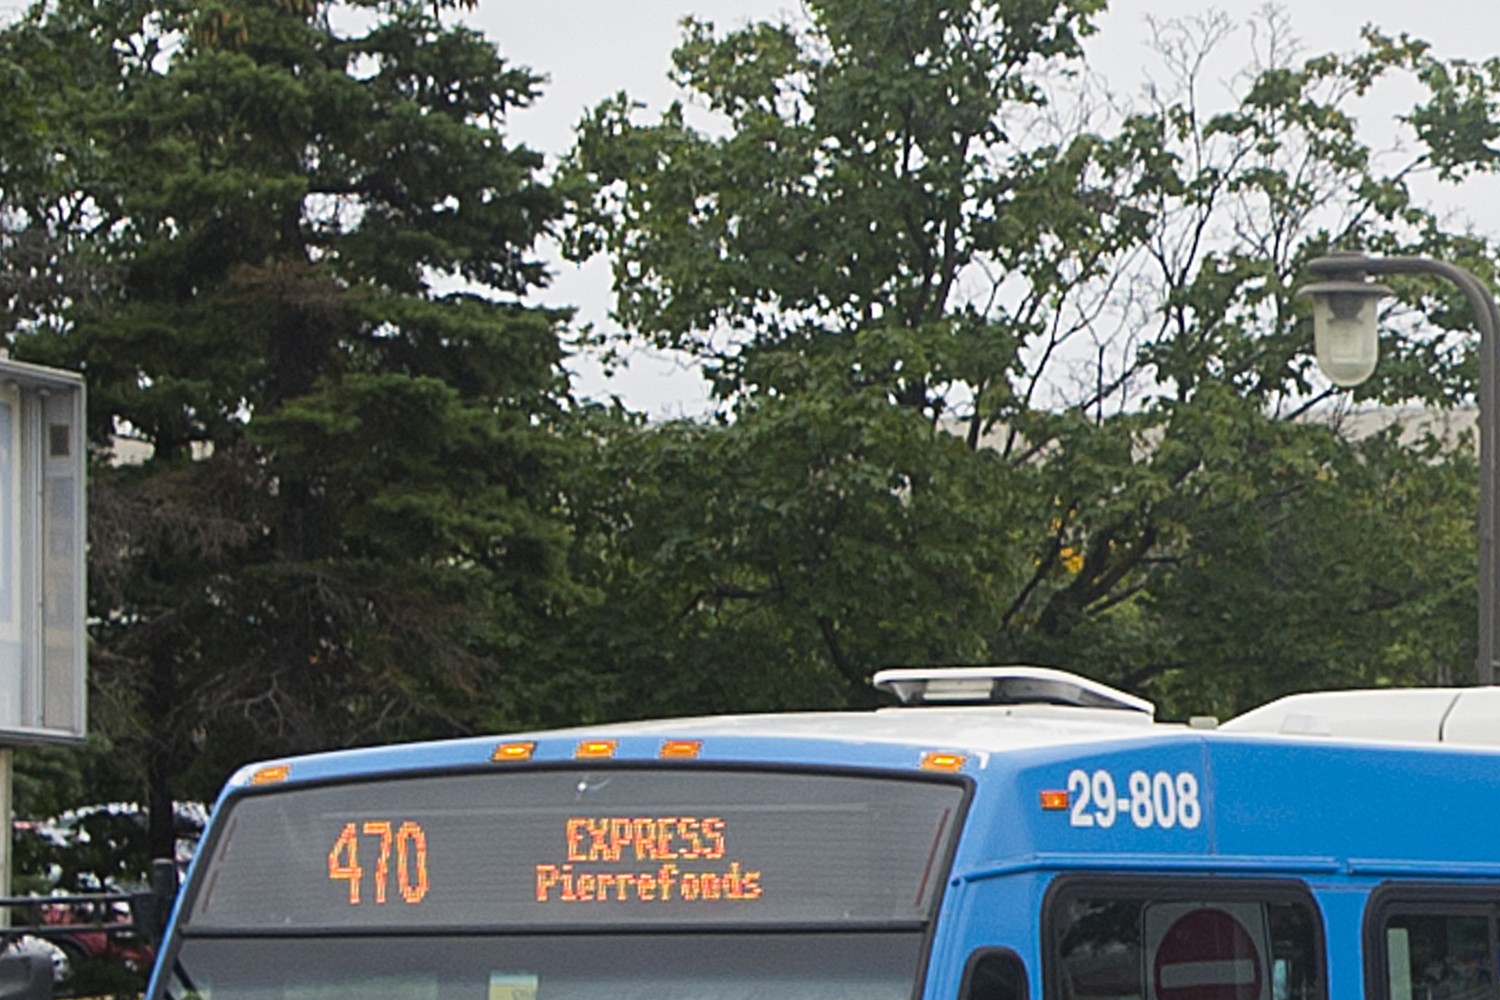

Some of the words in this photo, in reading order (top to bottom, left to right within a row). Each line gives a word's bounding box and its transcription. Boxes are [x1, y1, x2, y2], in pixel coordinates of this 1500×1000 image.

[1068, 769, 1201, 829] 29-808
[328, 821, 430, 905] 470
[566, 817, 726, 861] EXPRESS
[535, 863, 763, 902] Pierrefonds
